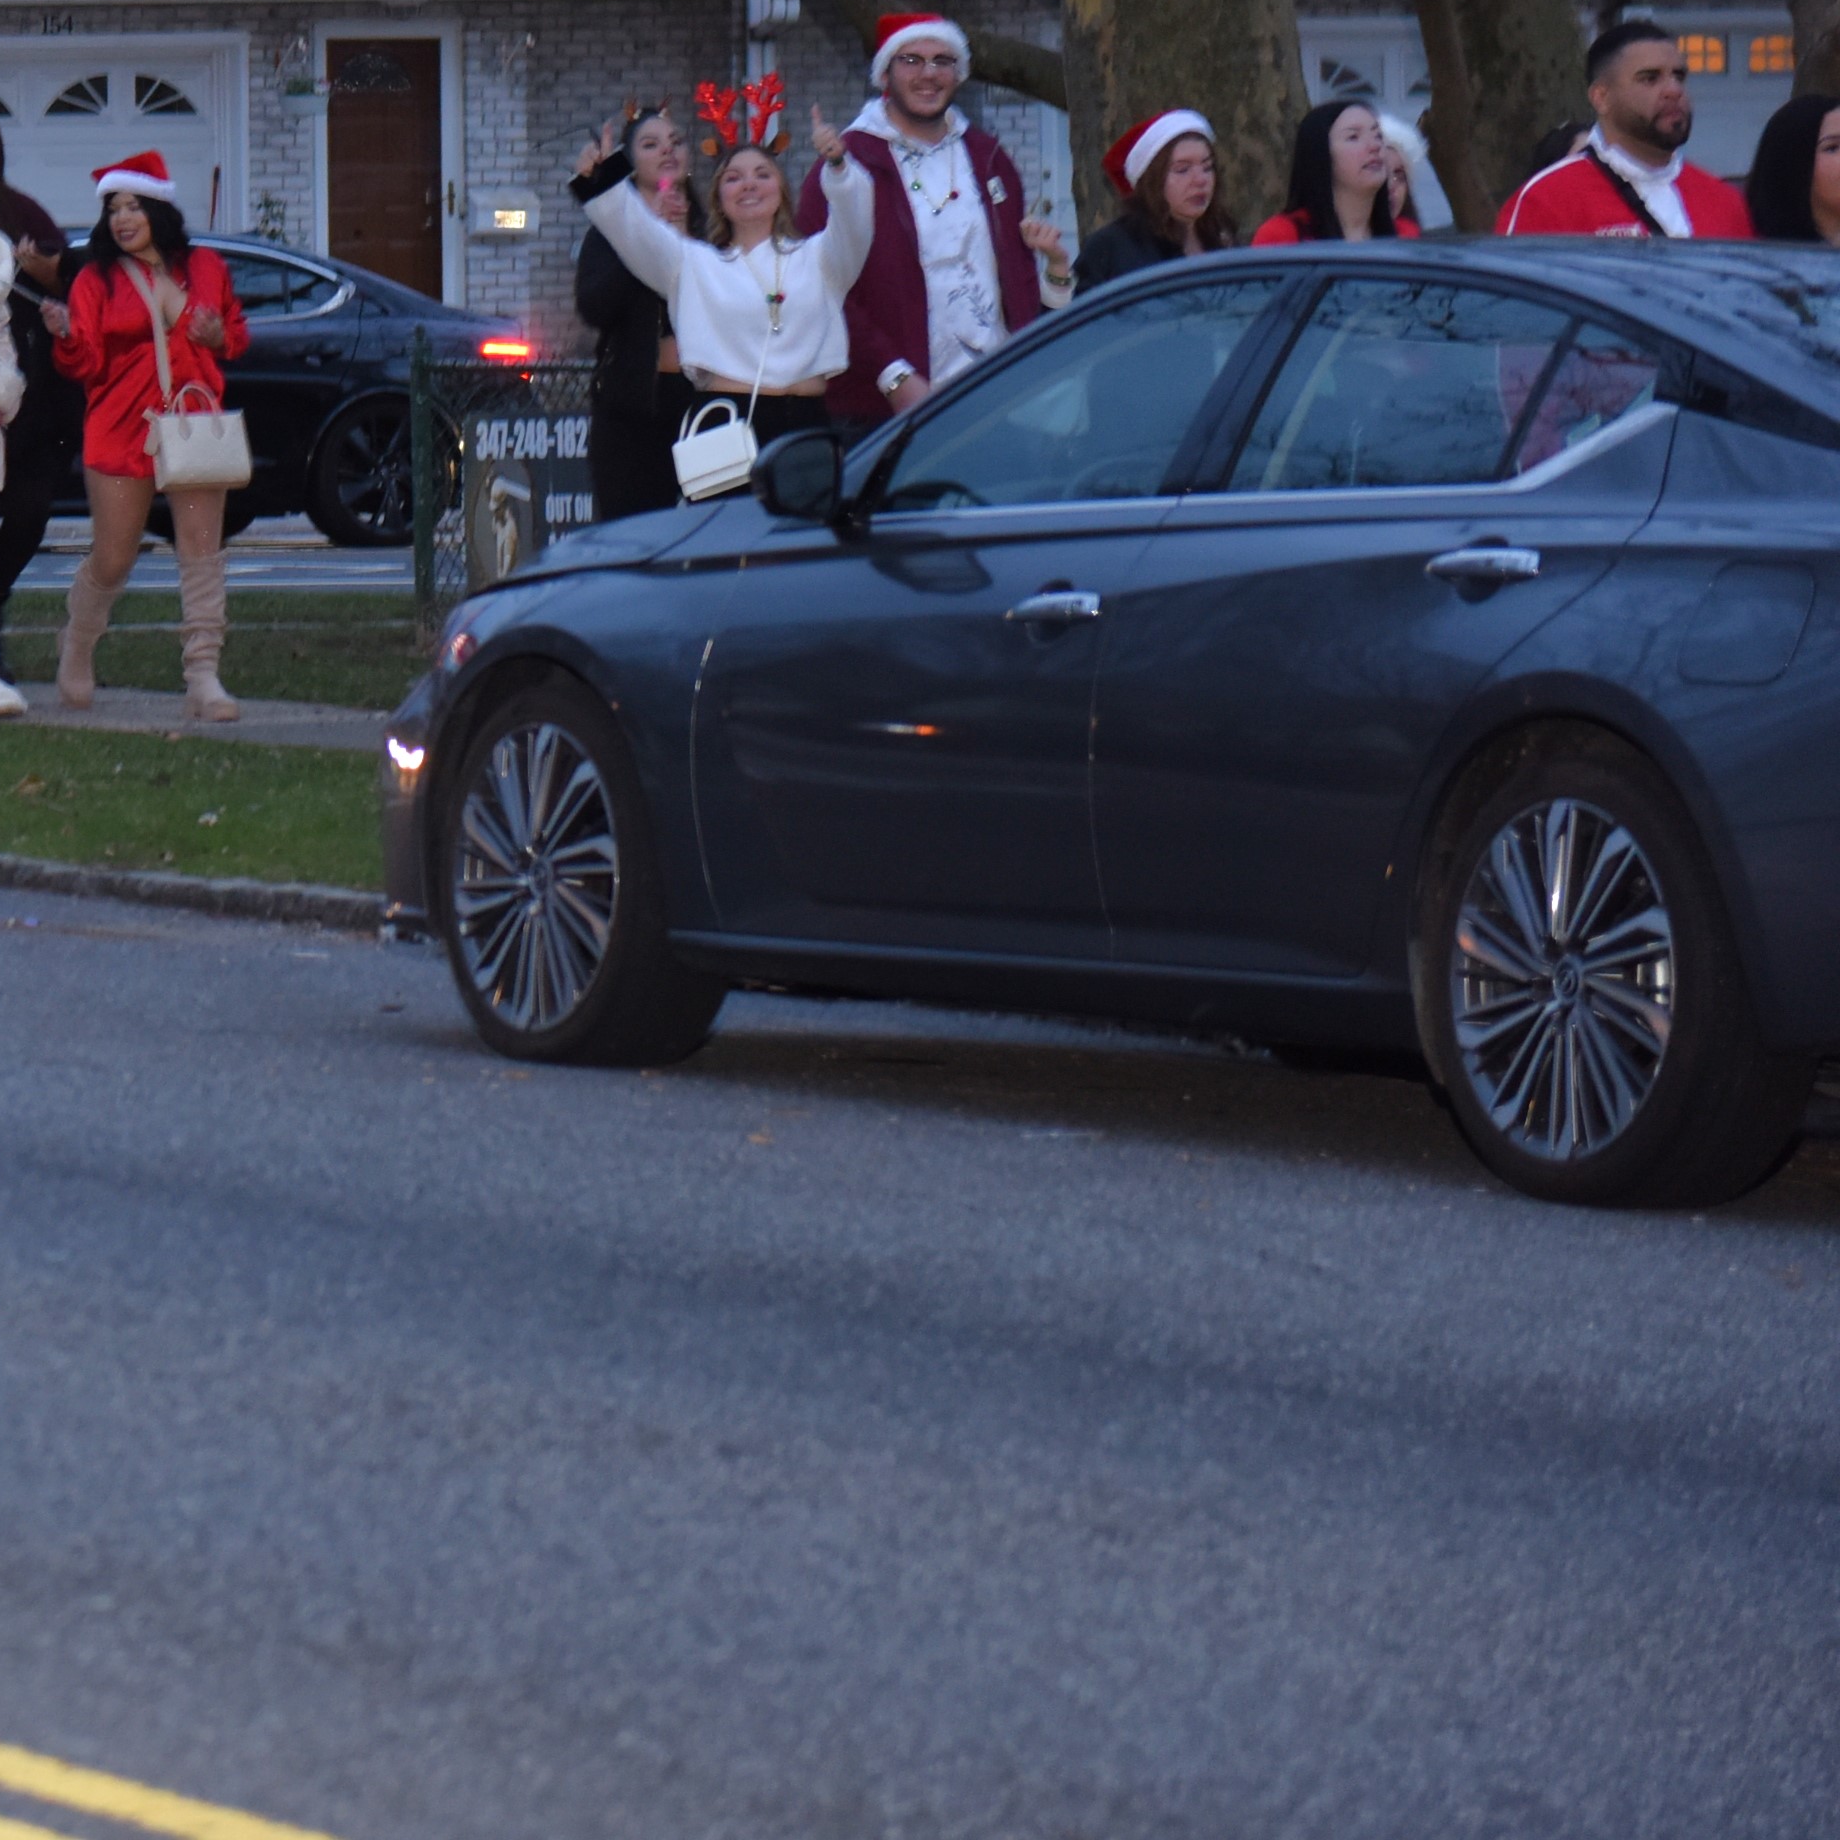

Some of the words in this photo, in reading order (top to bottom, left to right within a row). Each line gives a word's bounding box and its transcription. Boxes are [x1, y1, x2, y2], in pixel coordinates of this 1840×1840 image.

[41, 15, 74, 36] 154
[475, 416, 593, 461] 347-248-182
[545, 493, 573, 523] OUT
